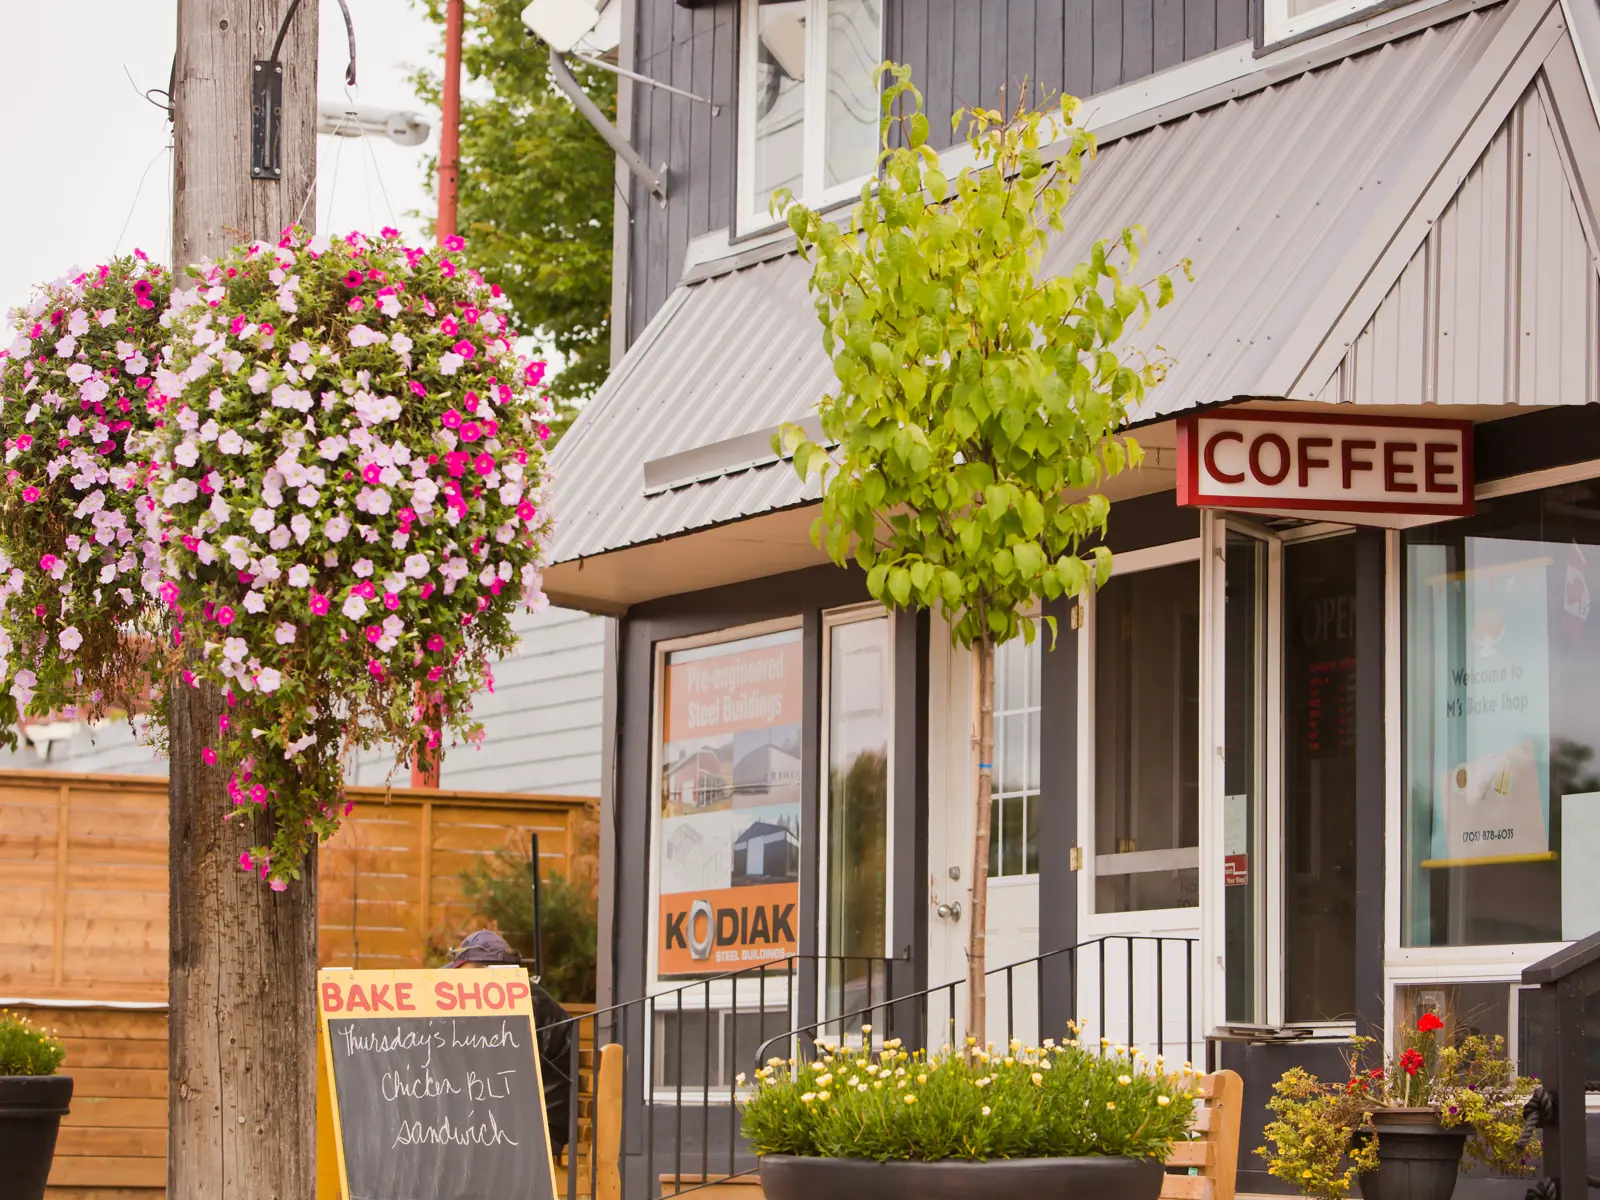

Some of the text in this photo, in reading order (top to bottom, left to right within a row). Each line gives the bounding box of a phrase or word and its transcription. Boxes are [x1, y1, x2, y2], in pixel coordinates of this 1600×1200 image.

[1203, 431, 1458, 493] COFFEE
[687, 651, 784, 694] Pre-engineered
[1451, 664, 1523, 687] Welcome to
[688, 689, 783, 730] Steel Buildings
[1446, 690, 1529, 718] M's Bake Shop
[1462, 830, 1481, 843] (705)
[665, 899, 796, 961] KODIAK
[715, 950, 740, 963] STEEL
[741, 947, 786, 961] BUILDINGS
[321, 981, 530, 1012] BAKE SHOP
[338, 1020, 446, 1068] Thursday's
[381, 1064, 516, 1101] Chicken BLT
